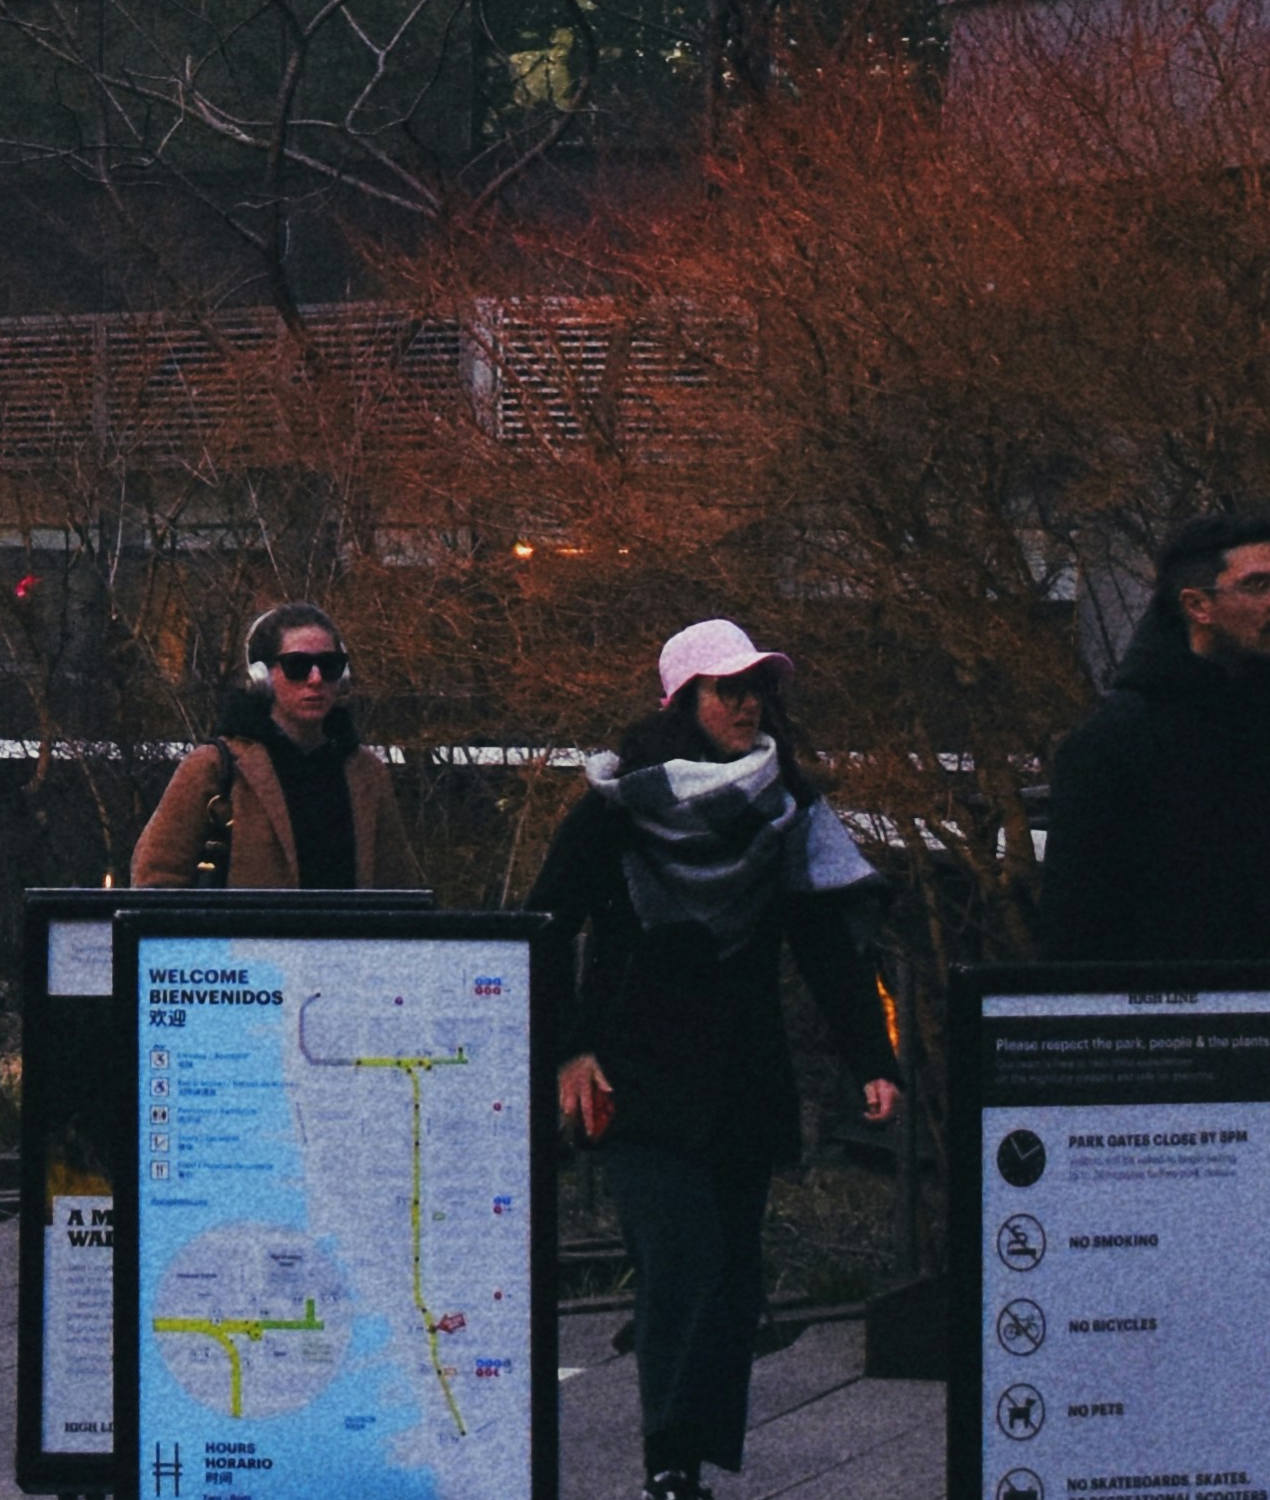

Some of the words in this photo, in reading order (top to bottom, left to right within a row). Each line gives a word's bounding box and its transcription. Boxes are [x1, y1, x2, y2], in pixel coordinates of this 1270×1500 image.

[149, 968, 249, 984] WELCOME
[149, 988, 284, 1006] BIENVENIDOS
[149, 1009, 186, 1027] 欢迎
[996, 1038, 1038, 1051] Please
[1041, 1038, 1090, 1053] respect
[1092, 1037, 1112, 1050] the
[1149, 1036, 1192, 1050] people
[1195, 1035, 1205, 1048] &
[1208, 1036, 1229, 1047] the
[1069, 1135, 1104, 1148] PARK
[1107, 1133, 1151, 1148] GATES
[1153, 1133, 1197, 1146] CLOSE
[1200, 1131, 1216, 1144] BY
[1219, 1130, 1248, 1143] 8PM
[67, 1209, 84, 1226] A
[1069, 1236, 1090, 1248] NO
[1093, 1234, 1159, 1248] SMOKING
[1069, 1320, 1089, 1333] NO
[1092, 1318, 1157, 1332] BICYCLES
[1068, 1404, 1089, 1417] NO
[1091, 1403, 1124, 1416] PETS
[65, 1421, 97, 1433] HIGH
[205, 1442, 256, 1454] HOURS
[205, 1457, 273, 1470] HORARIO
[205, 1471, 233, 1486] 时间
[1067, 1478, 1088, 1491] NO
